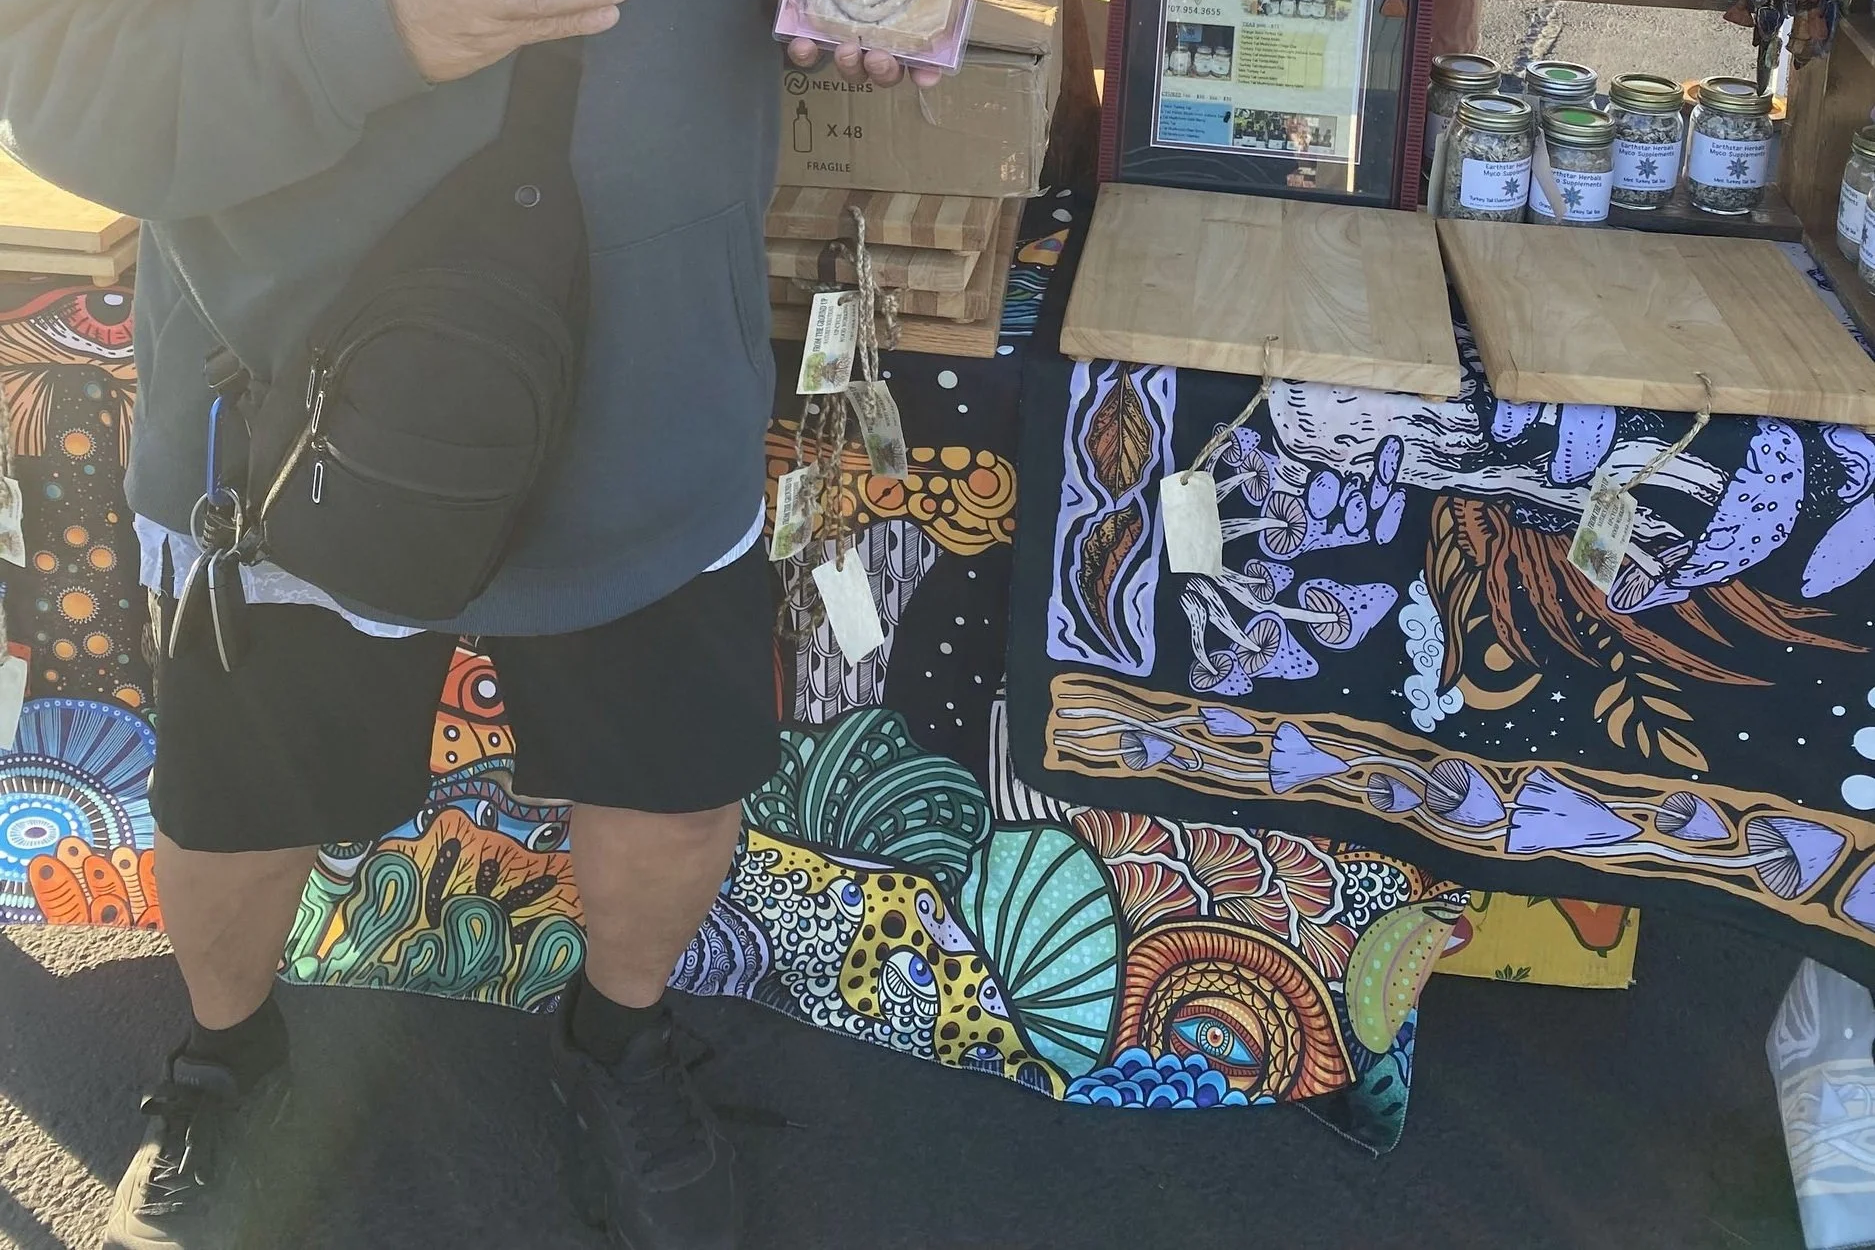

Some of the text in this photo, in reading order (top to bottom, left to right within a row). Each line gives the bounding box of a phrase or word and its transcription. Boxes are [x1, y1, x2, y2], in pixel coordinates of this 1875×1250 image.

[812, 81, 873, 93] NEVLERS
[827, 123, 863, 139] X 48
[1621, 142, 1650, 150] Earthstar
[1712, 142, 1743, 150] Earthstar
[1619, 147, 1635, 156] Myco
[1710, 148, 1726, 156] Myco
[807, 161, 851, 172] FRAGILE
[1553, 171, 1577, 179] rthstar
[1470, 195, 1485, 203] Turkey
[815, 328, 824, 339] THE
[1588, 512, 1597, 529] FROM
[1593, 502, 1601, 516] THE
